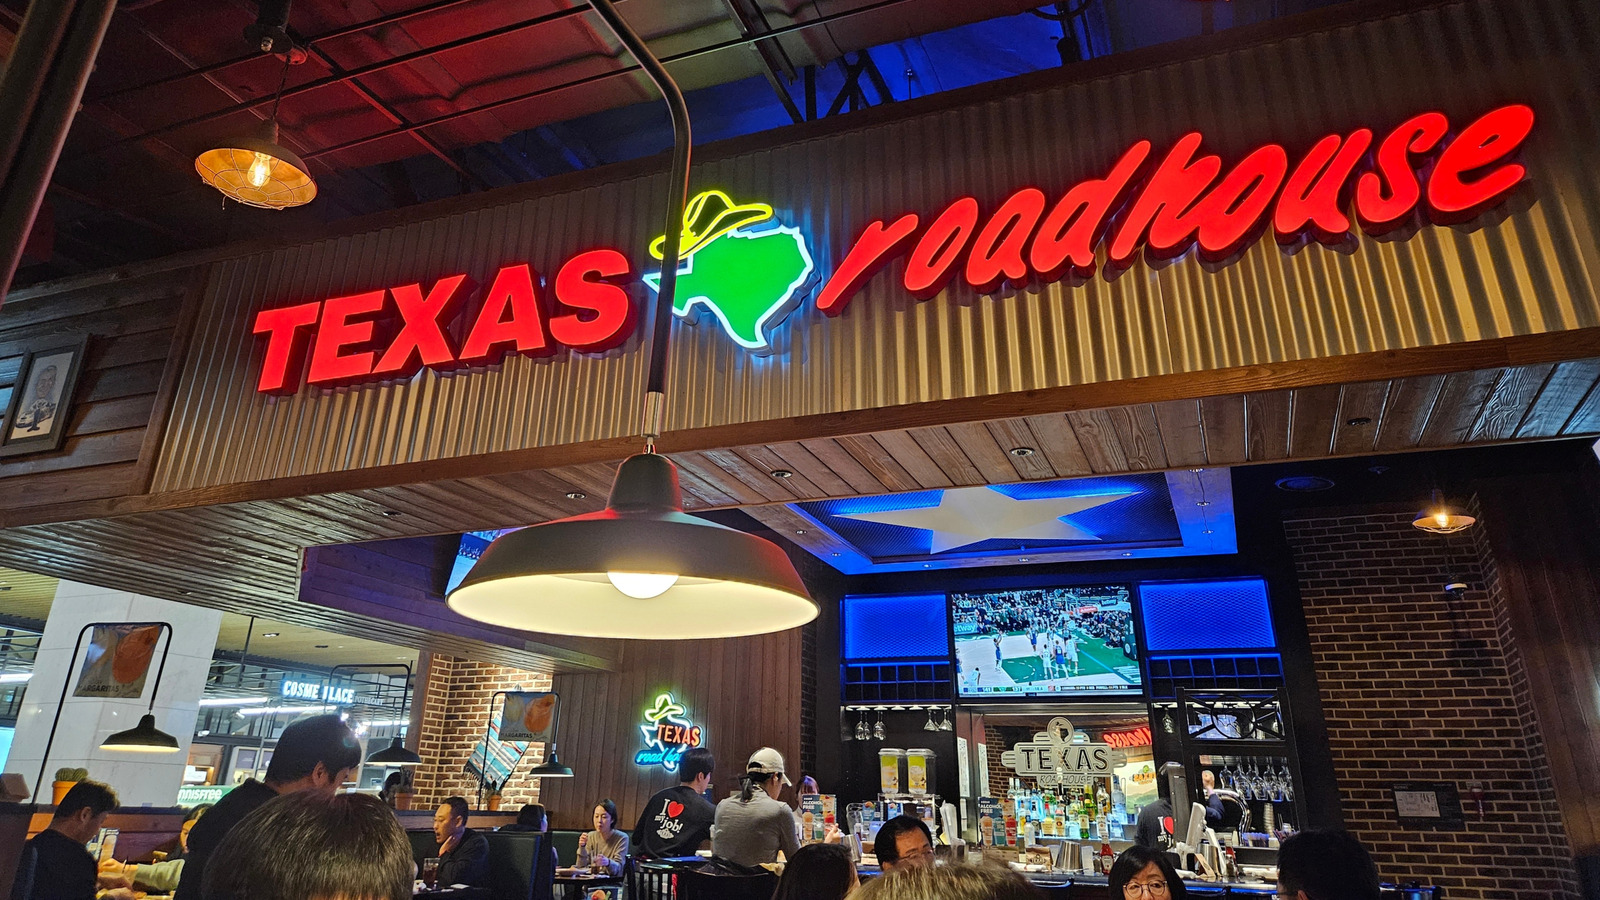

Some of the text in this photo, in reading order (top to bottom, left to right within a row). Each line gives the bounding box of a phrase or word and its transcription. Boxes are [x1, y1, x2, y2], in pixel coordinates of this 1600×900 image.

[253, 105, 1534, 392] TEXAS roadhouse
[283, 681, 320, 699] COSME
[657, 724, 701, 747] TEXAS
[637, 747, 681, 763] roadho
[1019, 747, 1109, 771] TEXAS
[1039, 774, 1092, 784] ROAHOUSE
[660, 798, 670, 815] I
[660, 816, 684, 834] job!
